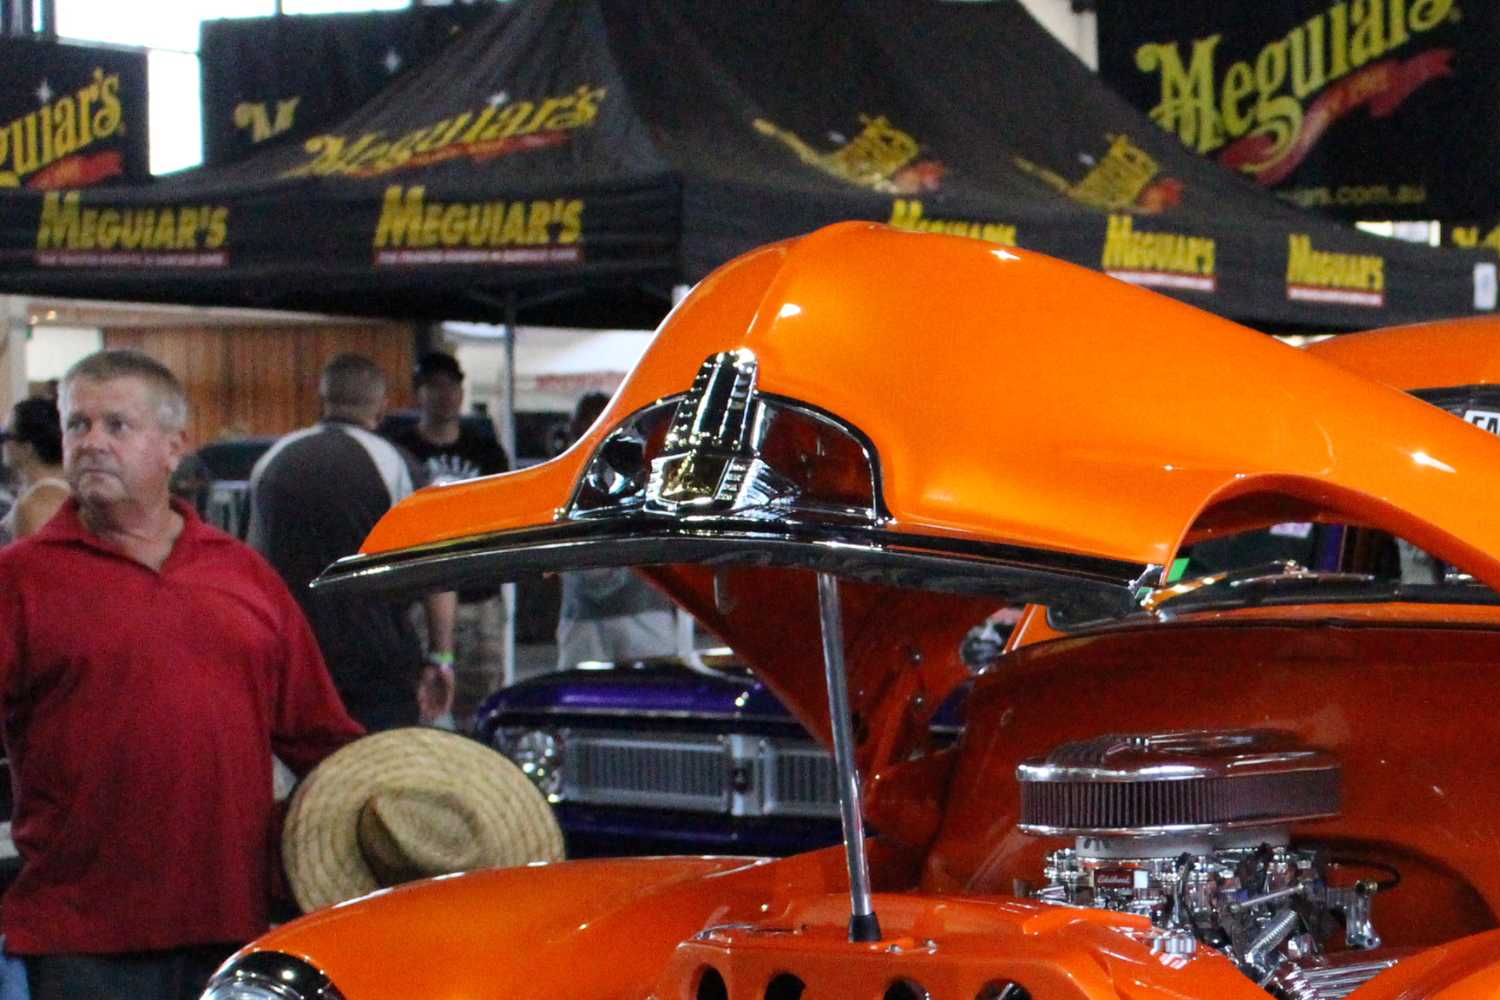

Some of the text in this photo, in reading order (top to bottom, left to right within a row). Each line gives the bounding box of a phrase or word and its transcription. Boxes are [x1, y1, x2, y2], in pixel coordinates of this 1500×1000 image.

[1134, 0, 1454, 173] Meguiar
[36, 190, 228, 250] MEGUIAR'S
[374, 184, 584, 248] MEGUIAR'S
